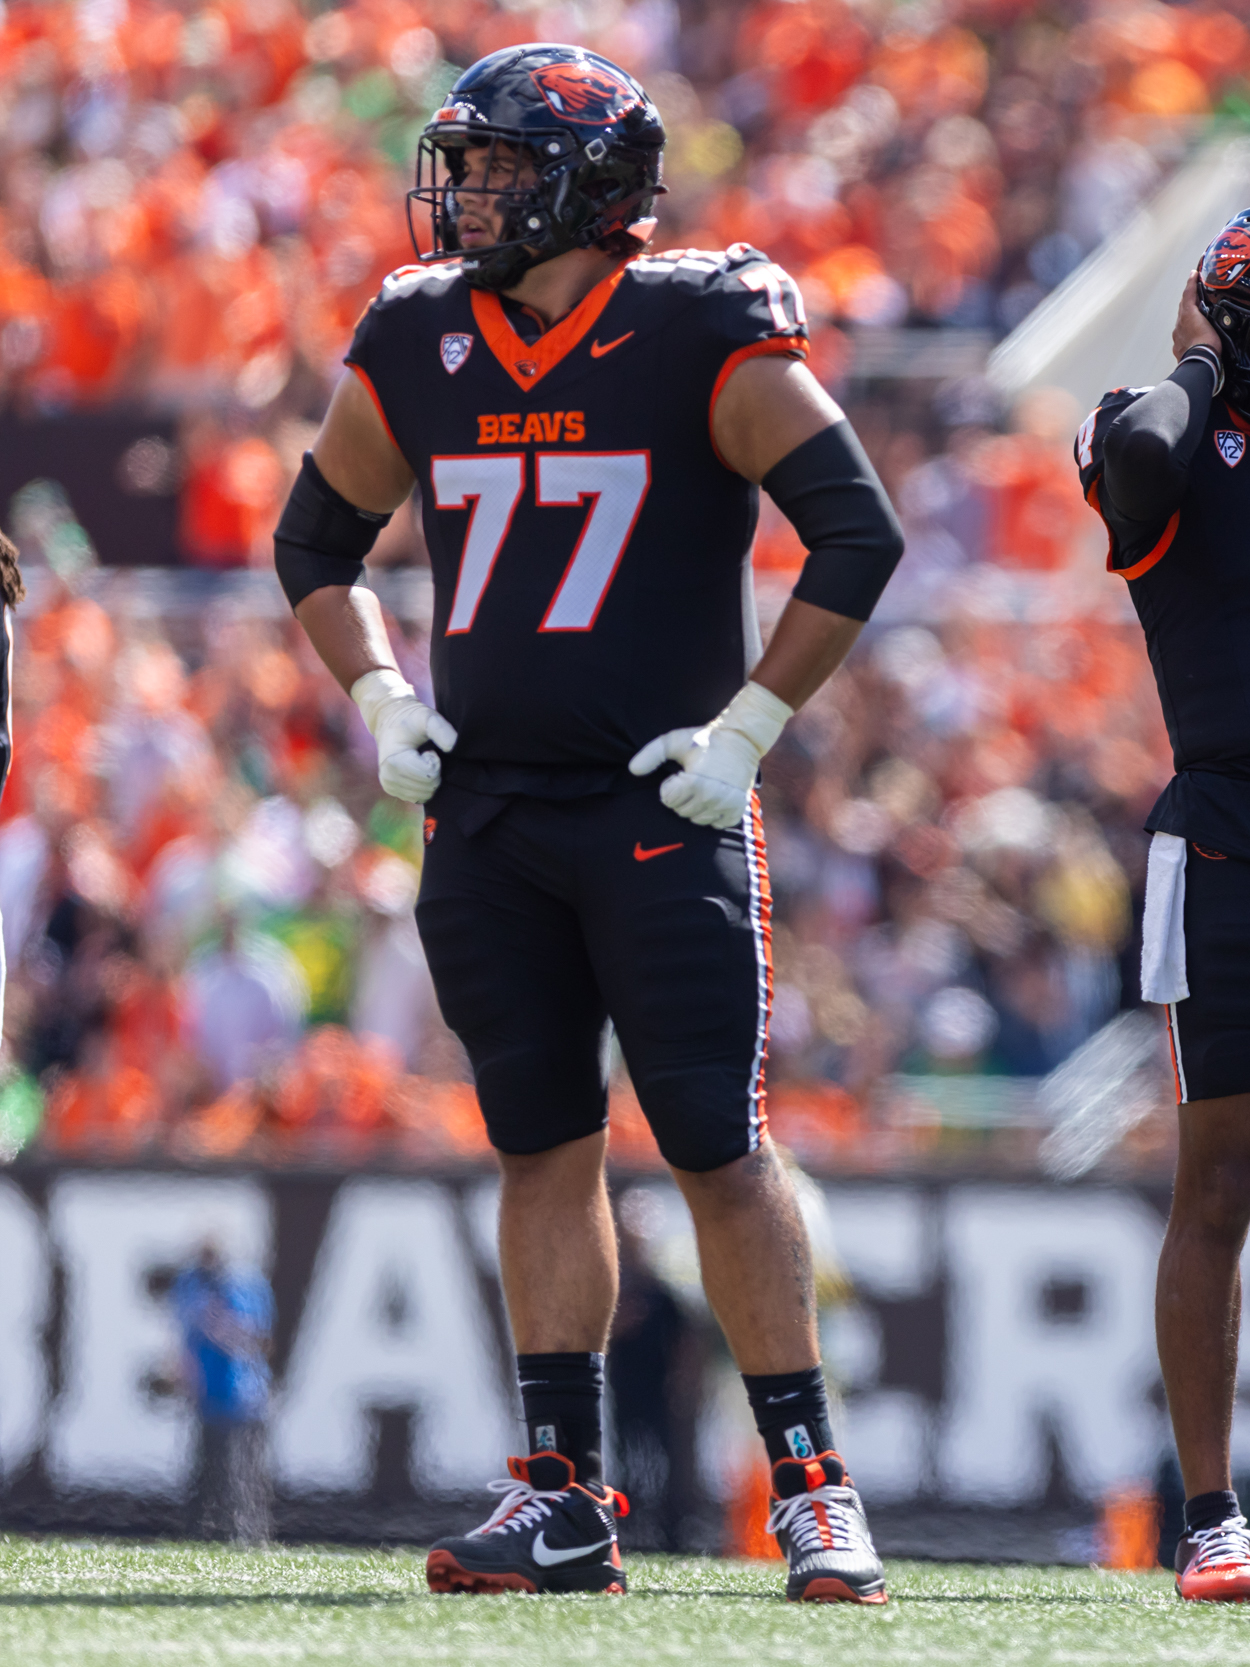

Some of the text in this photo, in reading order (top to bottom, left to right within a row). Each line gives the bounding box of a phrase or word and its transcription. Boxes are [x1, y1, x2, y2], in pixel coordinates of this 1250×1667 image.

[445, 350, 460, 365] 12
[477, 410, 586, 445] BEAVS
[1077, 406, 1103, 471] 4
[1216, 431, 1244, 452] PAC
[1224, 445, 1239, 459] 12
[430, 449, 652, 636] 77
